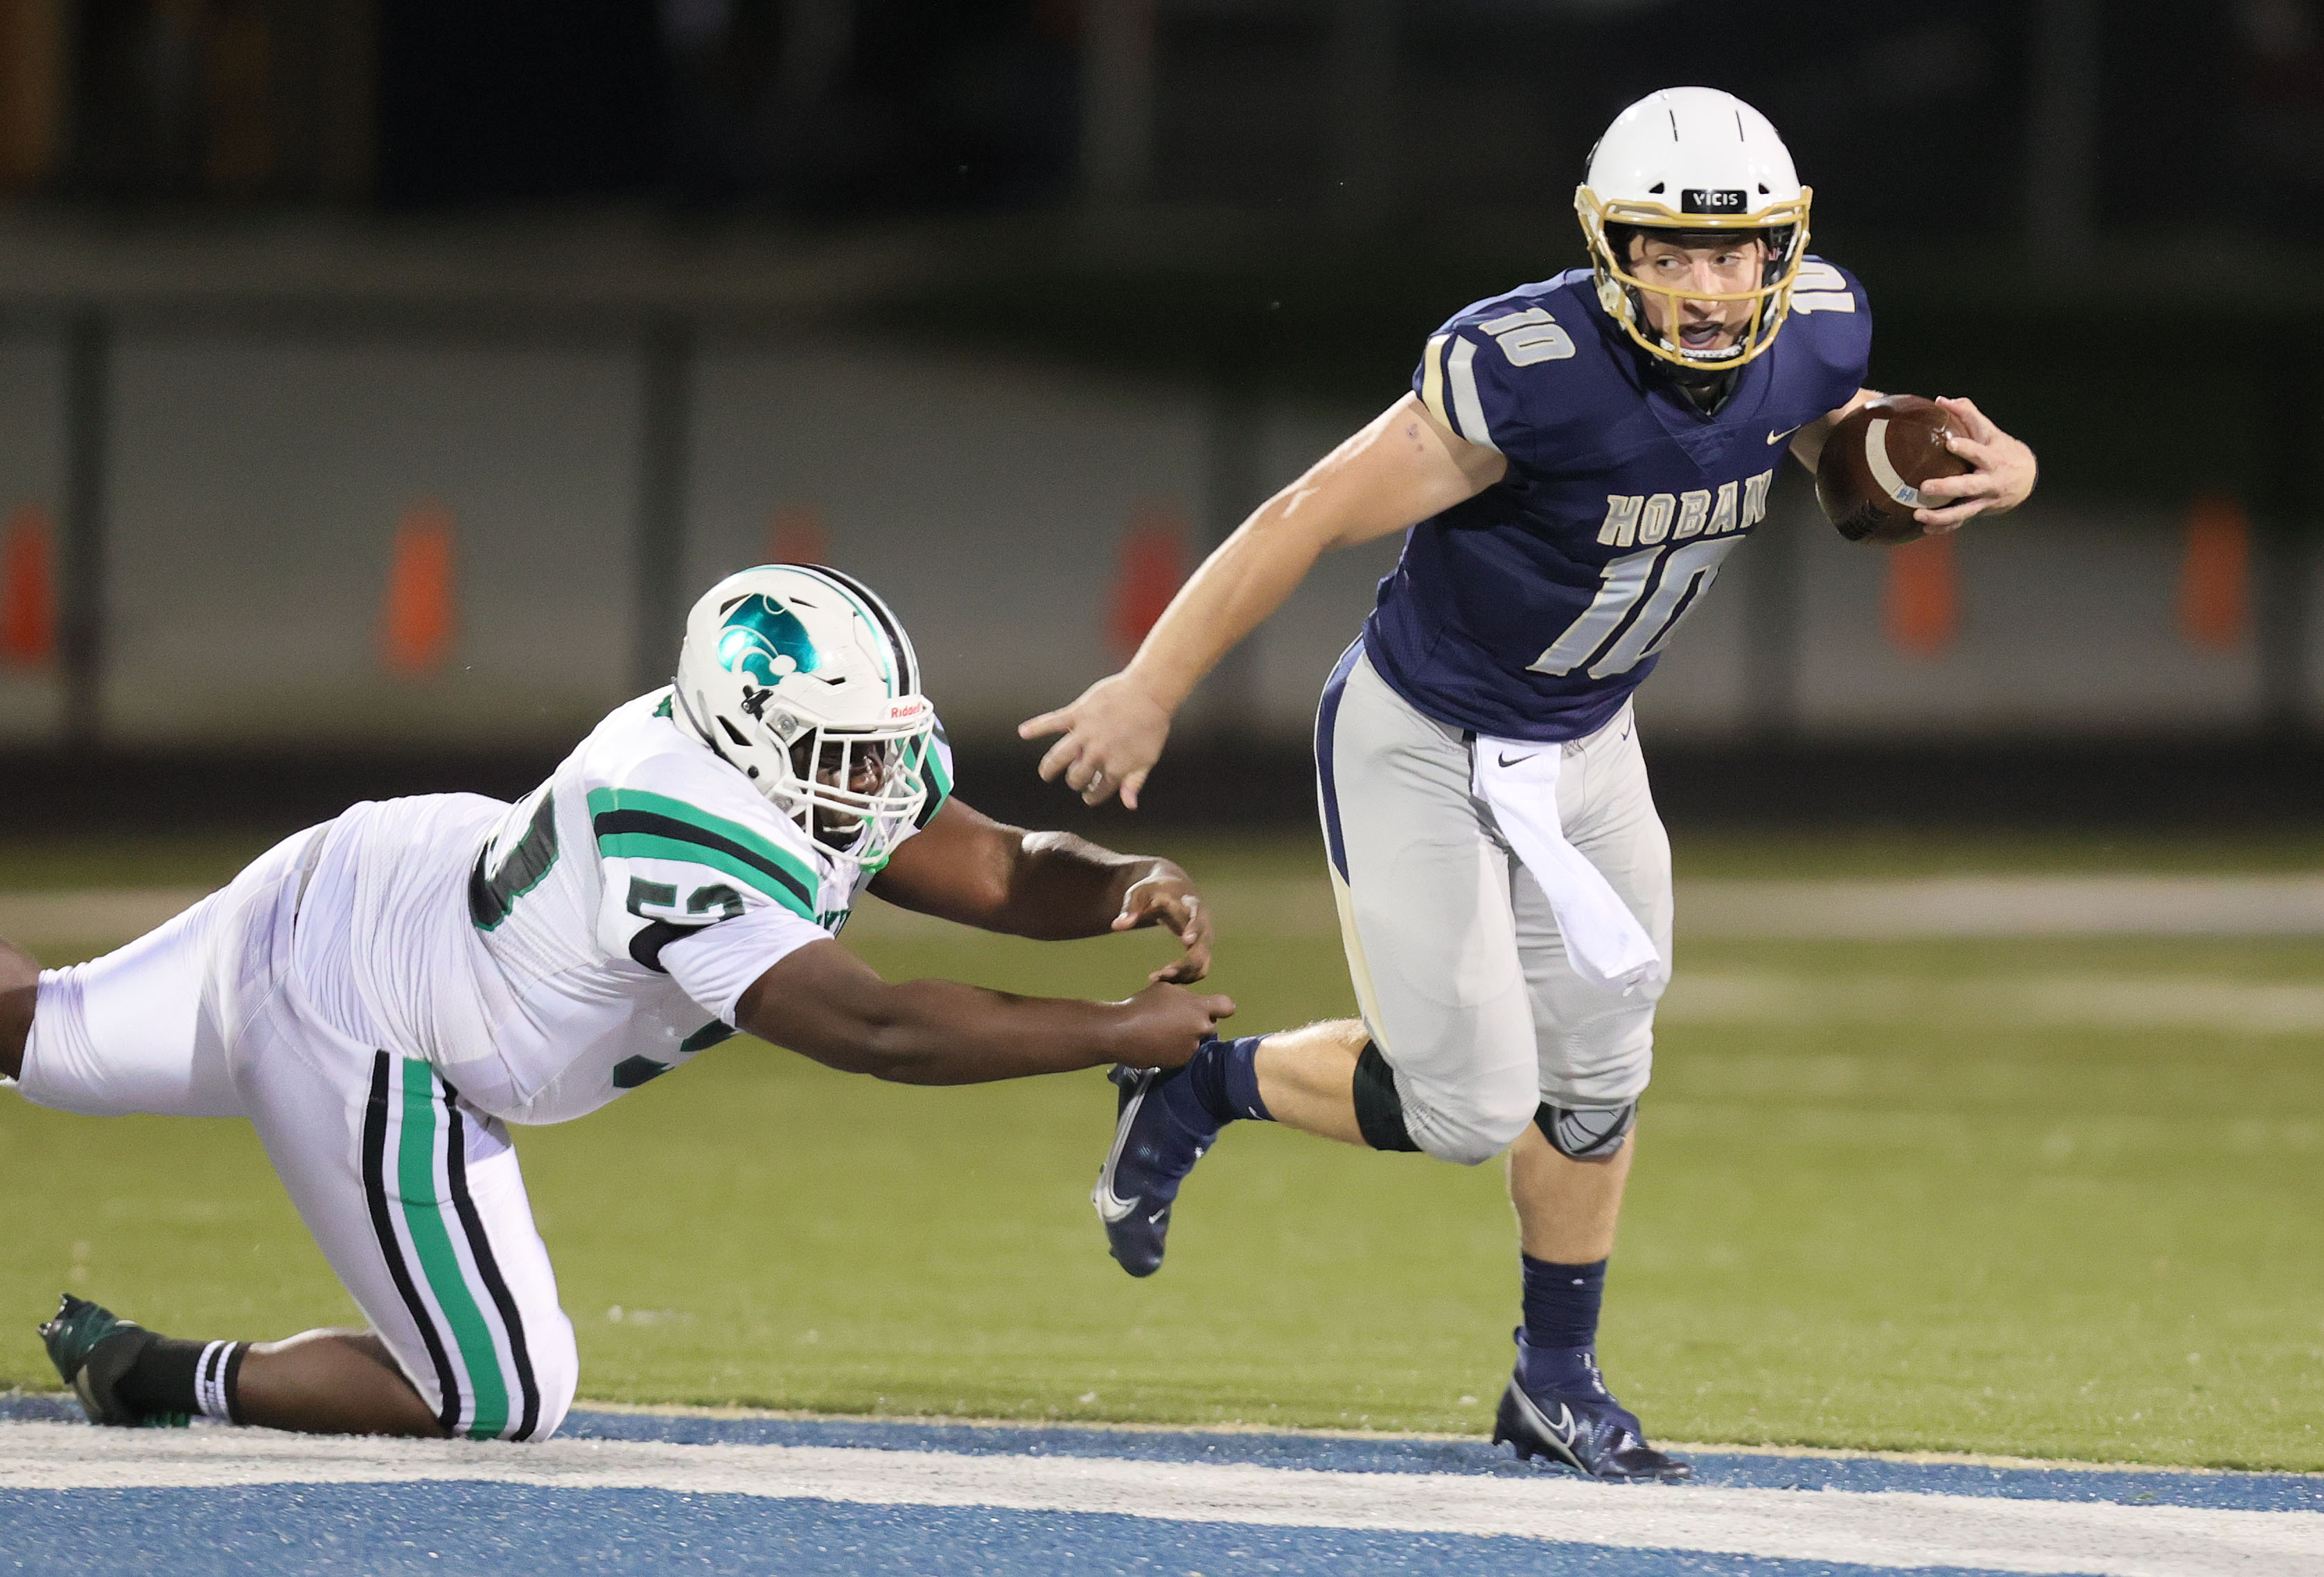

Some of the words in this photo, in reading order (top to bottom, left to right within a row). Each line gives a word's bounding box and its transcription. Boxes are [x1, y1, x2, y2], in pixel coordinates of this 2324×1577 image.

[1693, 192, 1739, 206] VICIS
[1477, 307, 1577, 367] 10
[1596, 468, 1774, 547] HOBAN
[1524, 534, 1747, 680] 10
